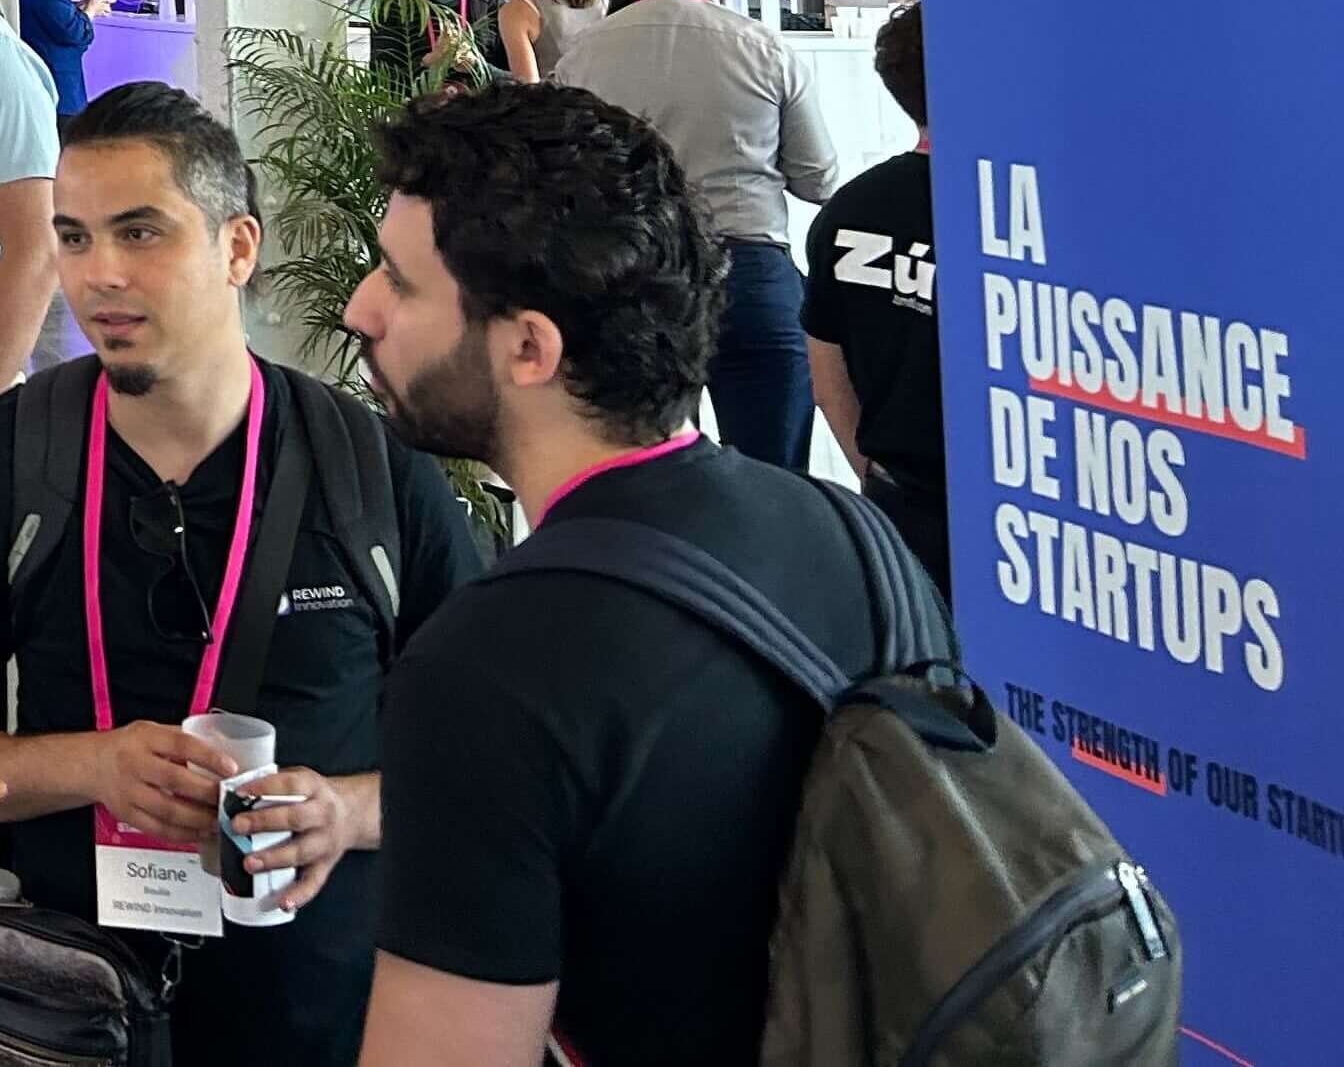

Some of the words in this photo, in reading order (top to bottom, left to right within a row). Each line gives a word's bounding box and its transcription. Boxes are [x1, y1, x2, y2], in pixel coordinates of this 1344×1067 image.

[977, 159, 1047, 265] LA
[983, 272, 1296, 443] PUISSANCE
[989, 386, 1060, 500] DE
[1073, 407, 1189, 536] NOS
[292, 585, 345, 600] REWIND
[994, 503, 1284, 691] STARTUPS
[1006, 683, 1044, 735] THE
[1051, 701, 1162, 784] STRENGTH
[1167, 747, 1199, 796] OF
[1206, 762, 1259, 821] OUR
[127, 862, 187, 882] Sofiane
